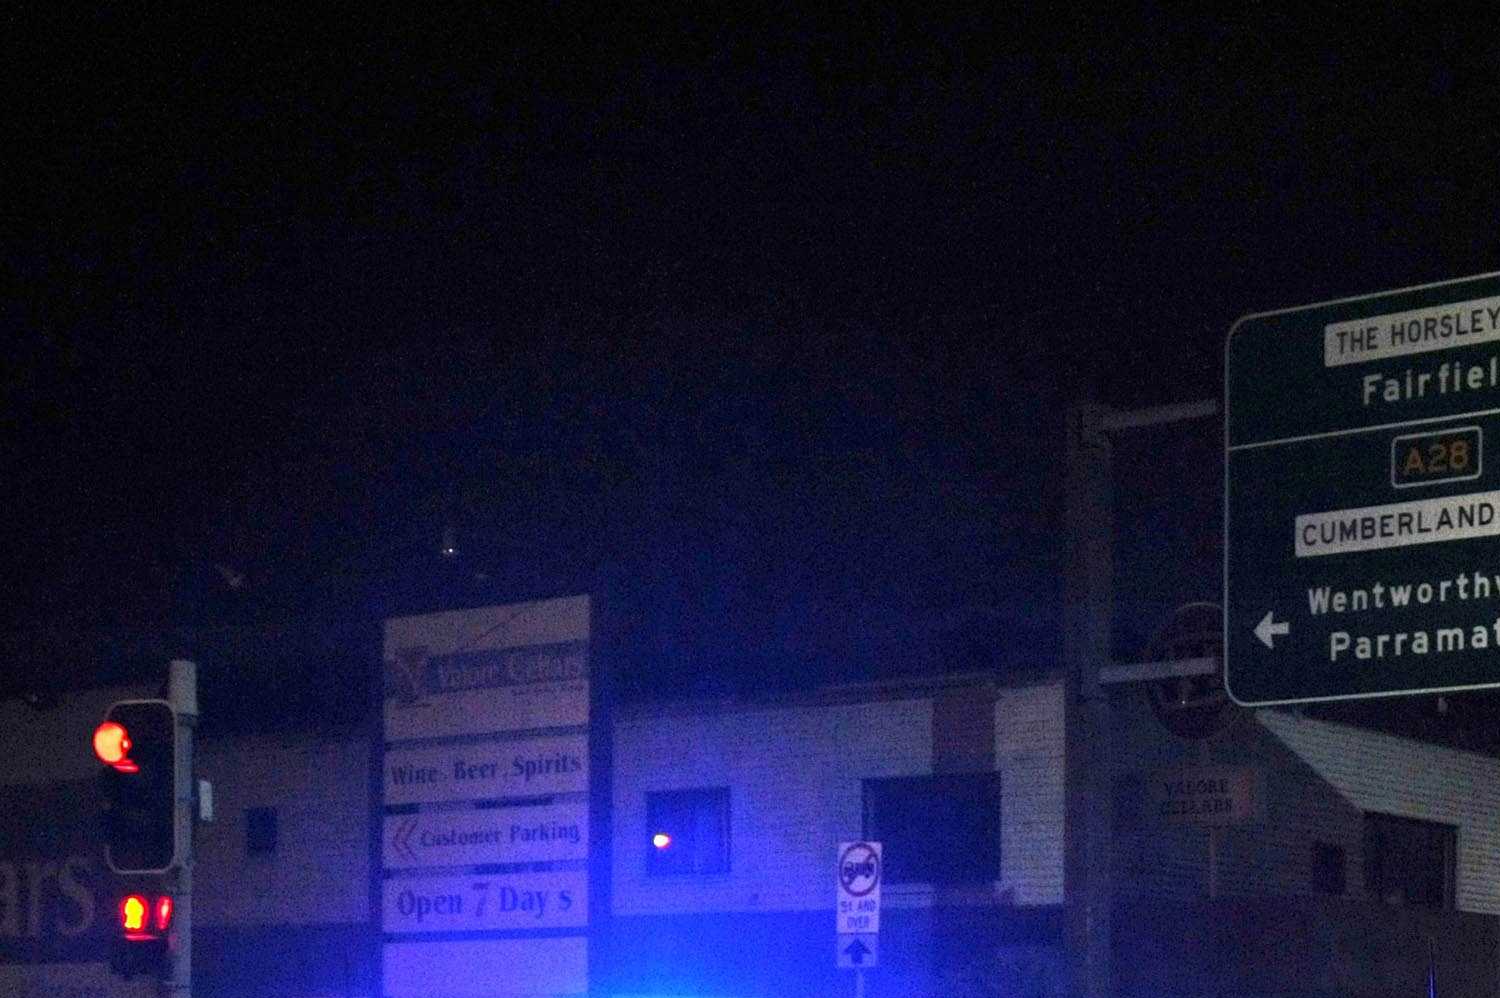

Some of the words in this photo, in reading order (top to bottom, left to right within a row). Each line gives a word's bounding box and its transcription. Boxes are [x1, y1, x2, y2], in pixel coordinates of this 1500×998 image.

[1336, 325, 1380, 355] THE
[1390, 306, 1500, 349] HORSLEY
[1404, 441, 1470, 472] A28
[1302, 502, 1494, 547] CUMBERLAND
[420, 828, 501, 848] Customer
[510, 823, 581, 845] Parking
[397, 889, 463, 923] Open
[471, 882, 491, 918] 7
